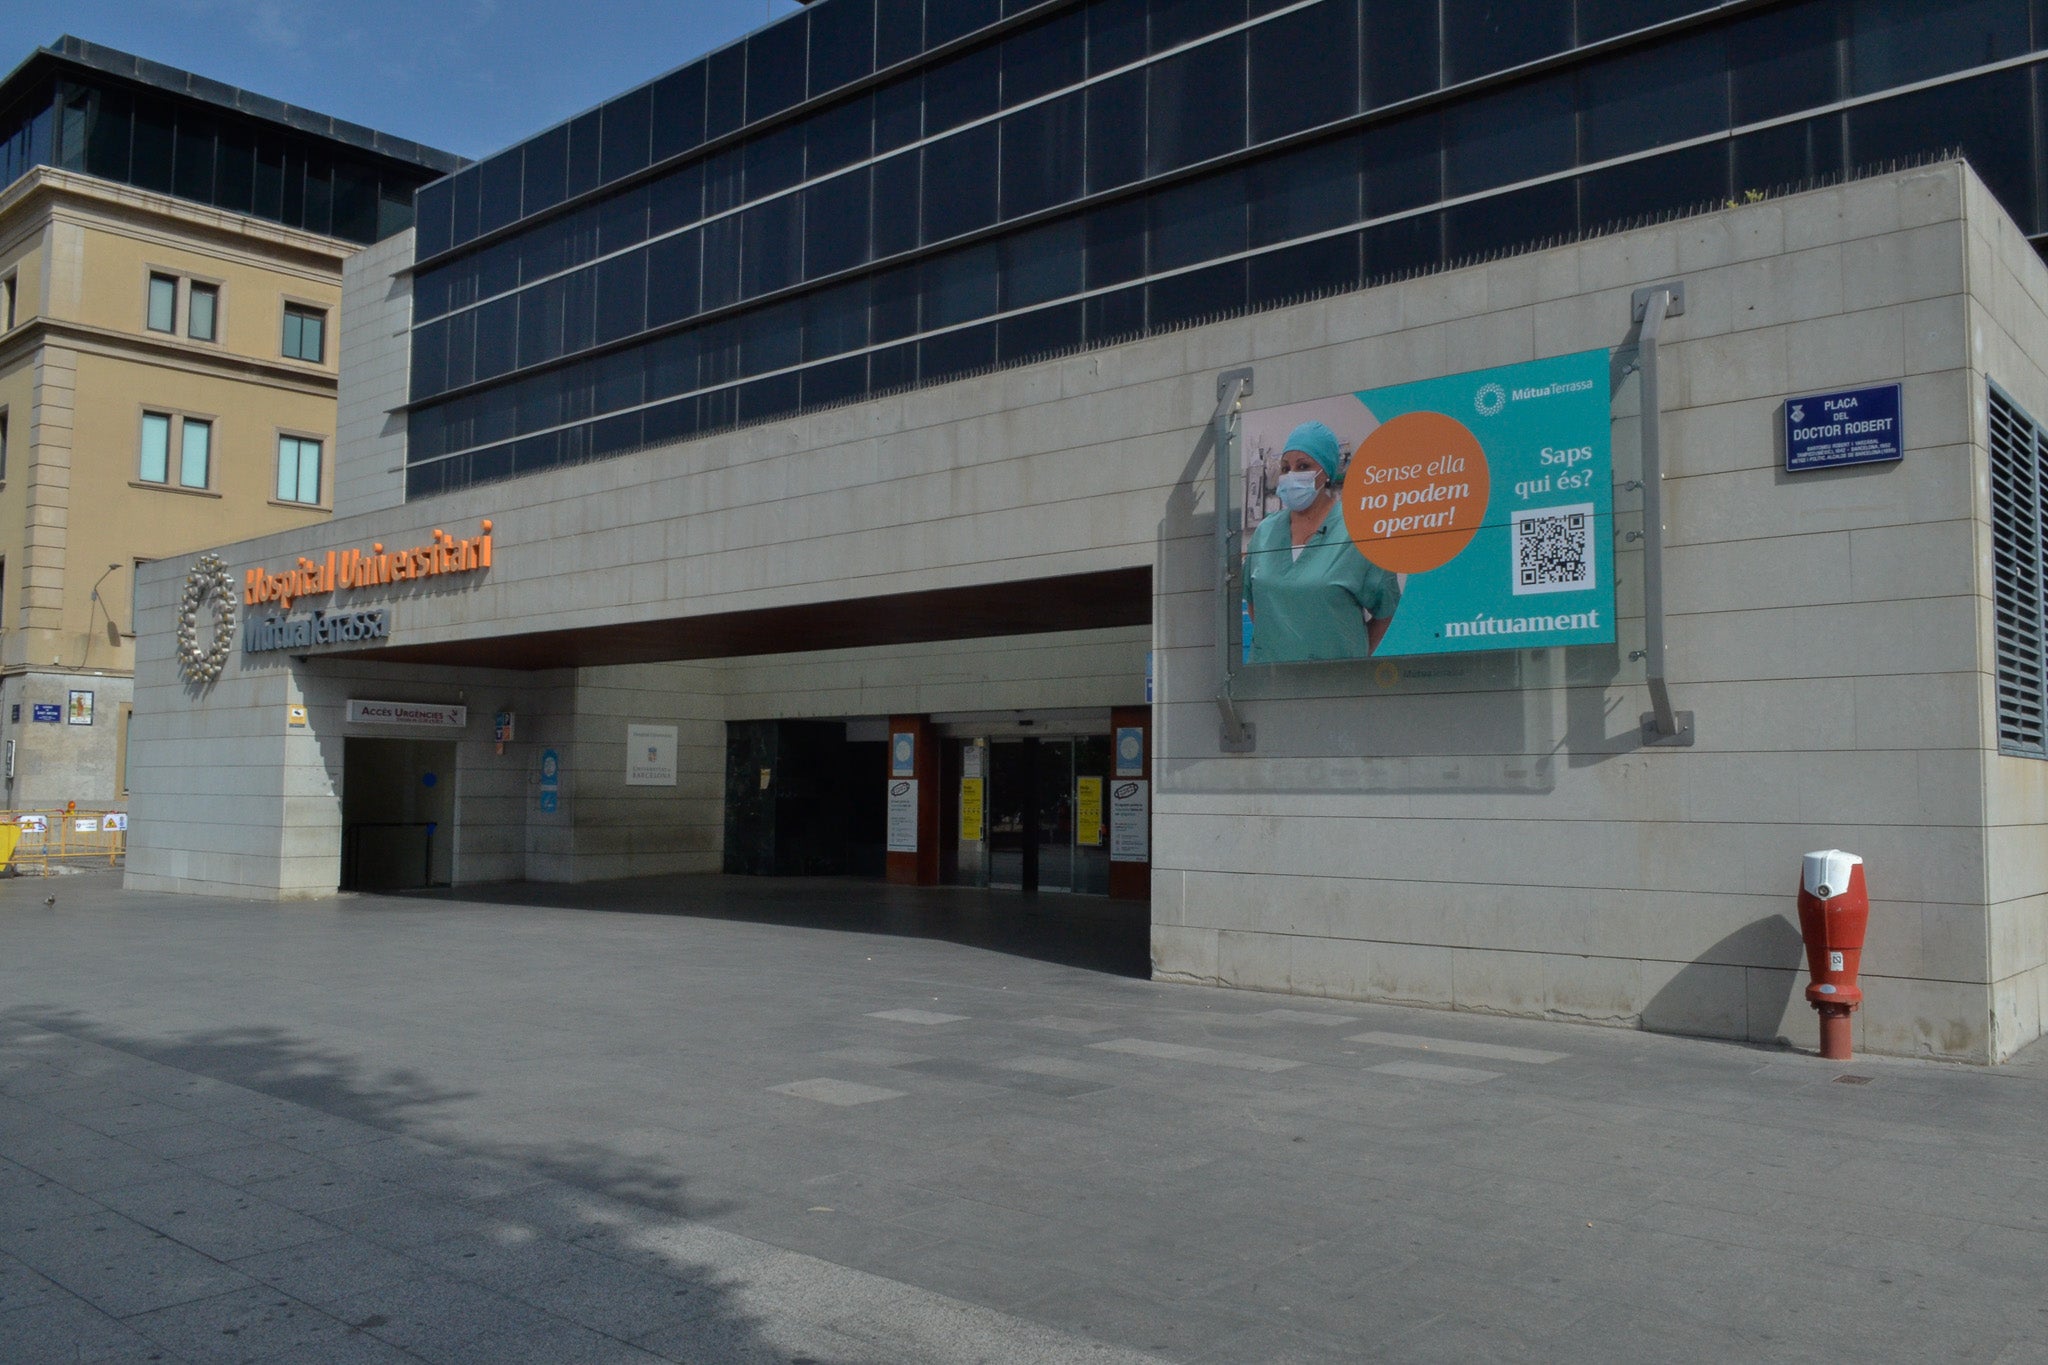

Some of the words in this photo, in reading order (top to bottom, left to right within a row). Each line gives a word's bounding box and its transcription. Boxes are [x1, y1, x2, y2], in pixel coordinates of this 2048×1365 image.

[1512, 379, 1593, 401] MútuaTerrassa
[1793, 424, 1841, 441] DOCTOR
[1845, 418, 1893, 435] ROBERT
[1833, 412, 1849, 421] DEL
[1363, 464, 1421, 485] Sense
[1427, 454, 1465, 476] ella
[1540, 445, 1593, 467] Saps
[1360, 494, 1388, 510] no
[1392, 482, 1470, 511] podem
[1515, 472, 1550, 499] qui
[1557, 469, 1593, 490] és?
[1373, 506, 1456, 537] operar!
[245, 551, 335, 609] Hospital
[338, 519, 493, 589] Universitari
[1445, 609, 1600, 638] mútuament
